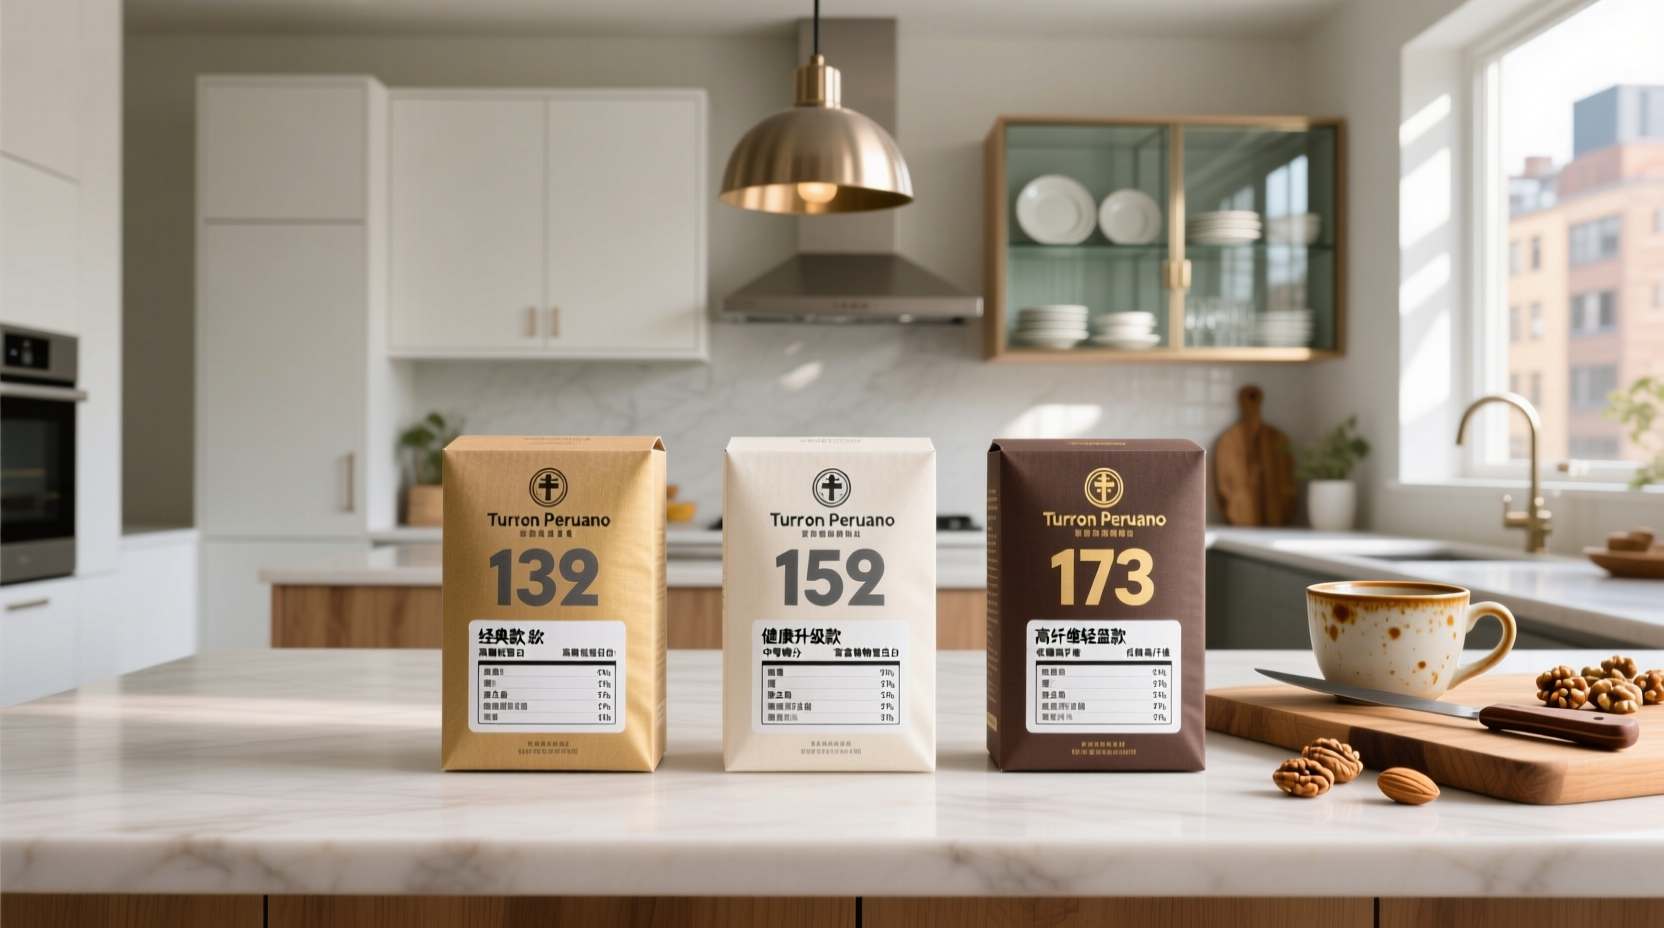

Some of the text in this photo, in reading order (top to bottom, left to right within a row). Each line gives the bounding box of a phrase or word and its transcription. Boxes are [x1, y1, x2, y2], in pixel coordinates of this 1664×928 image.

[487, 512, 611, 527] Turron Peruano
[770, 512, 895, 527] Turron Peruano
[1043, 511, 1167, 527] Turron Peruano
[1051, 547, 1155, 606] 173
[761, 627, 842, 645] 健康升级款
